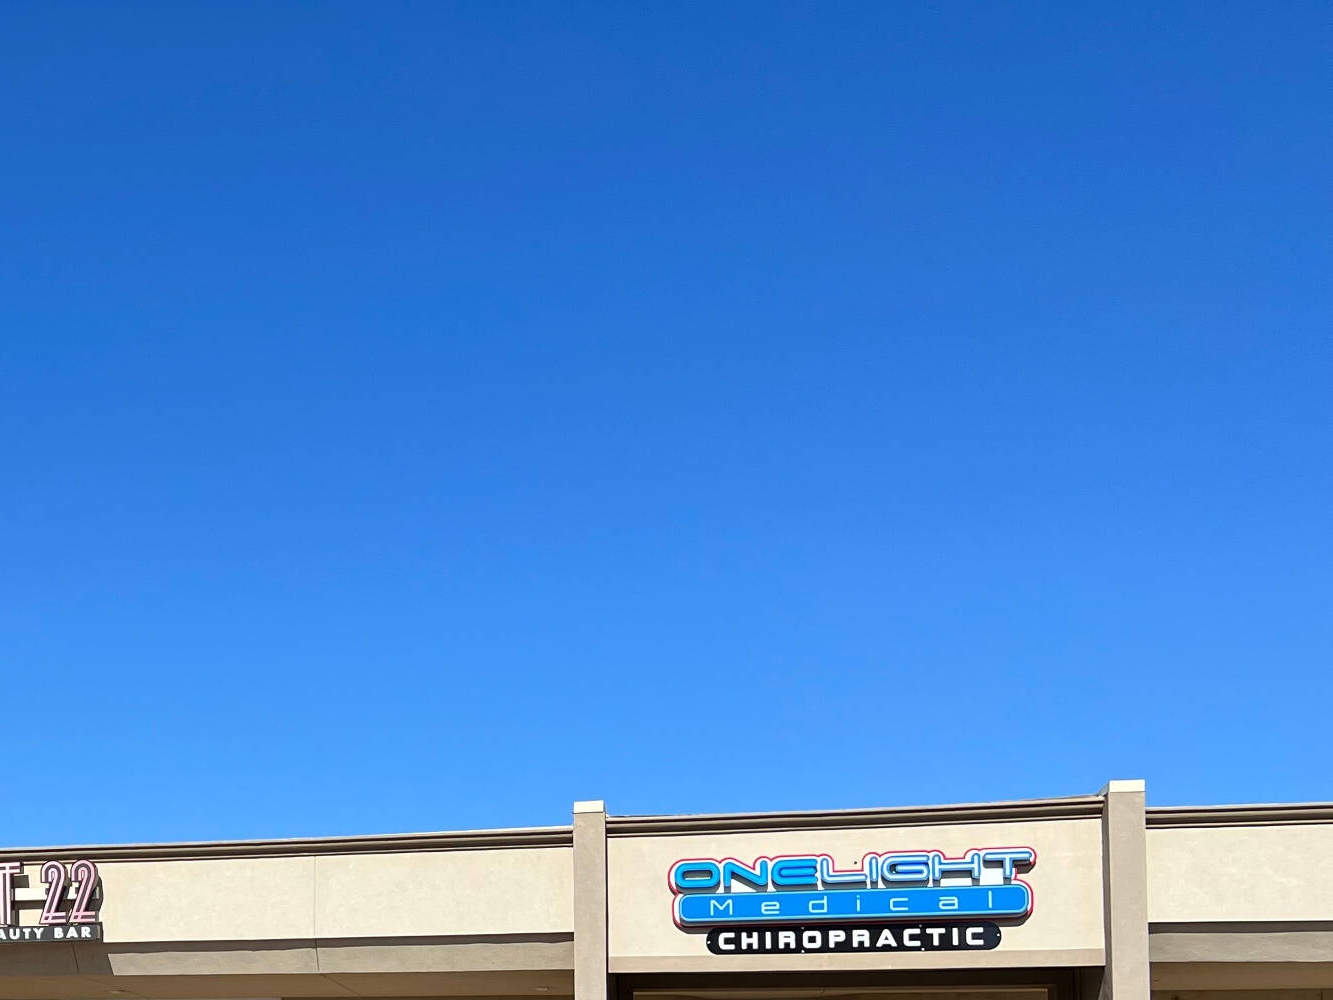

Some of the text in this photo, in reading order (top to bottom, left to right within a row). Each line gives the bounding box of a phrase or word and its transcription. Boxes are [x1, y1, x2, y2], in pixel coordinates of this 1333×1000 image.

[674, 850, 1035, 889] ONELIGHT
[40, 859, 97, 925] 22
[709, 889, 994, 916] Medical
[53, 925, 92, 940] BAR
[718, 926, 985, 951] CHIROPRACTIC
